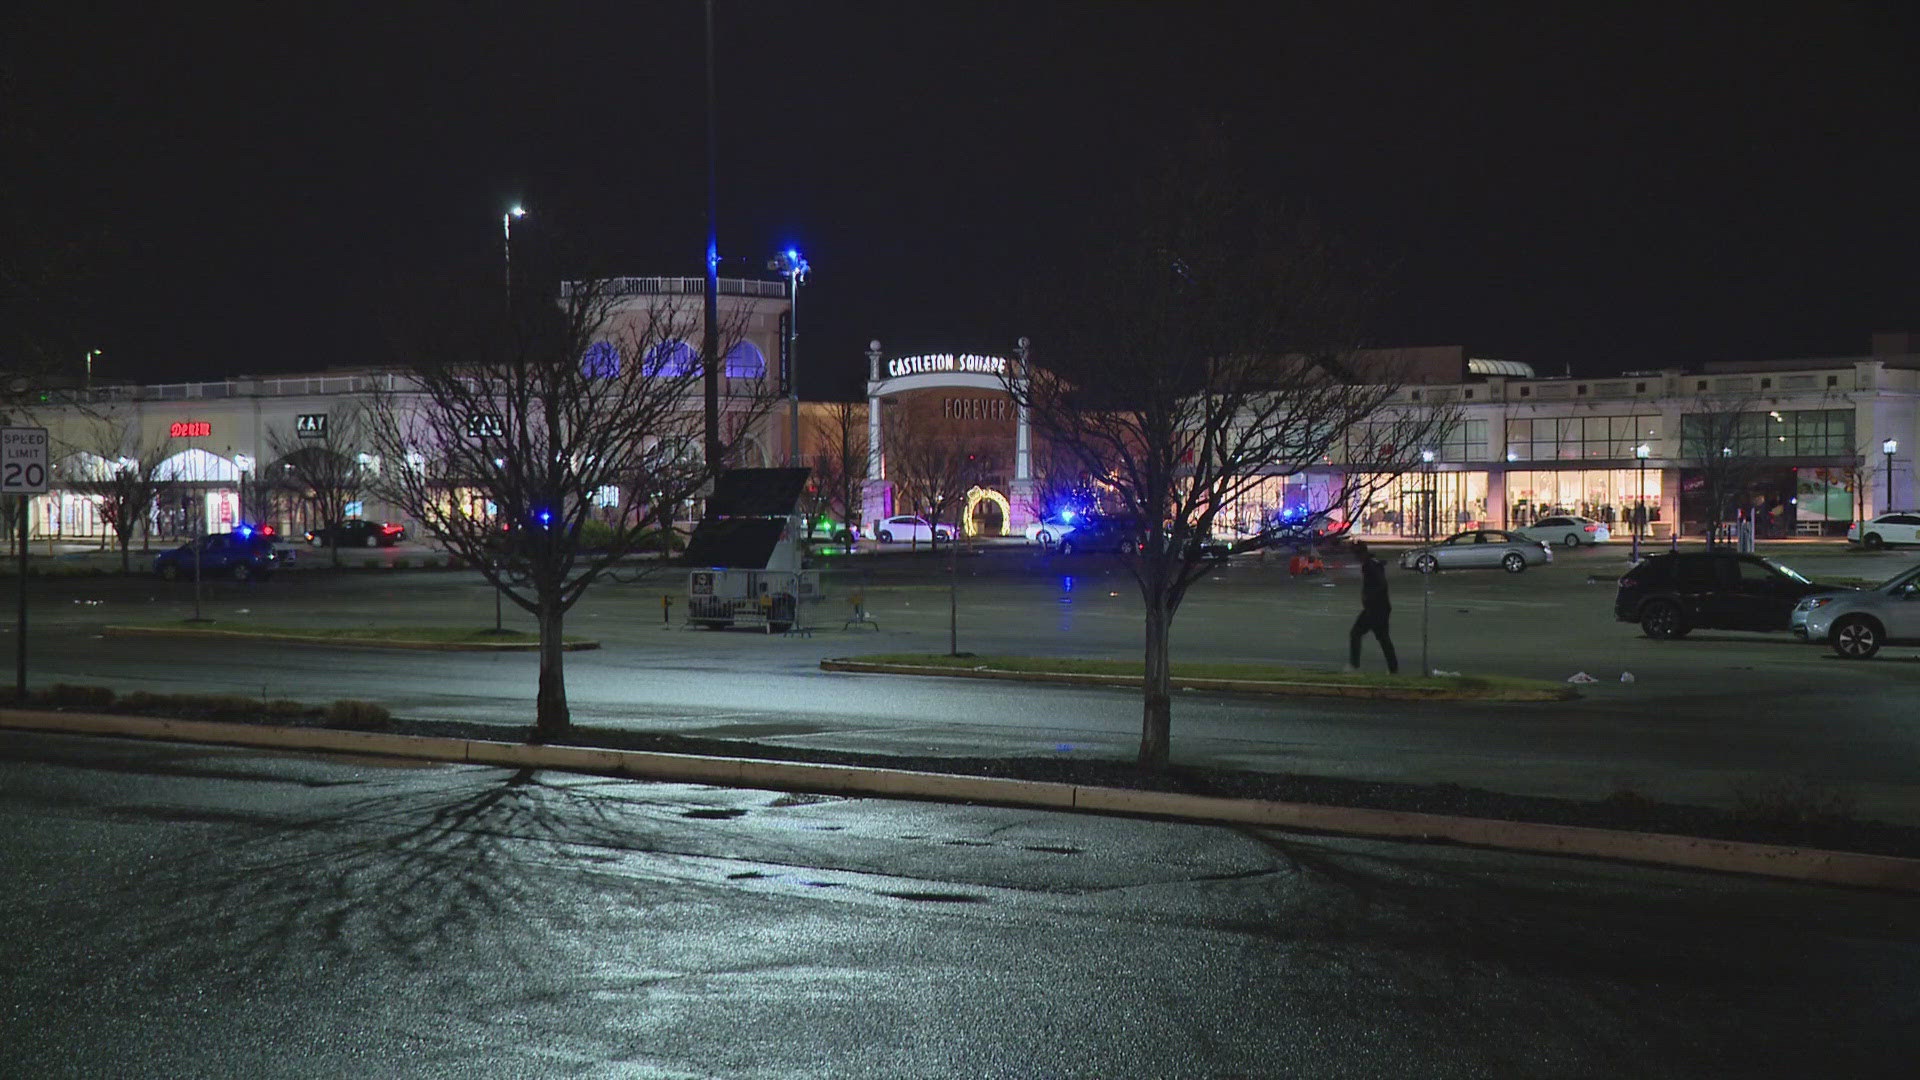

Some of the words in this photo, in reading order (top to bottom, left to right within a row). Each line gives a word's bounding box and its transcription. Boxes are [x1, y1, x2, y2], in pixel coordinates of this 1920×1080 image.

[889, 353, 954, 377] CASTLETON
[959, 353, 1006, 374] SQUARE
[944, 398, 1006, 420] FOREVER
[298, 416, 325, 430] KAY
[4, 434, 44, 445] SPEED
[8, 449, 39, 458] LIMIT
[4, 463, 44, 487] 20
